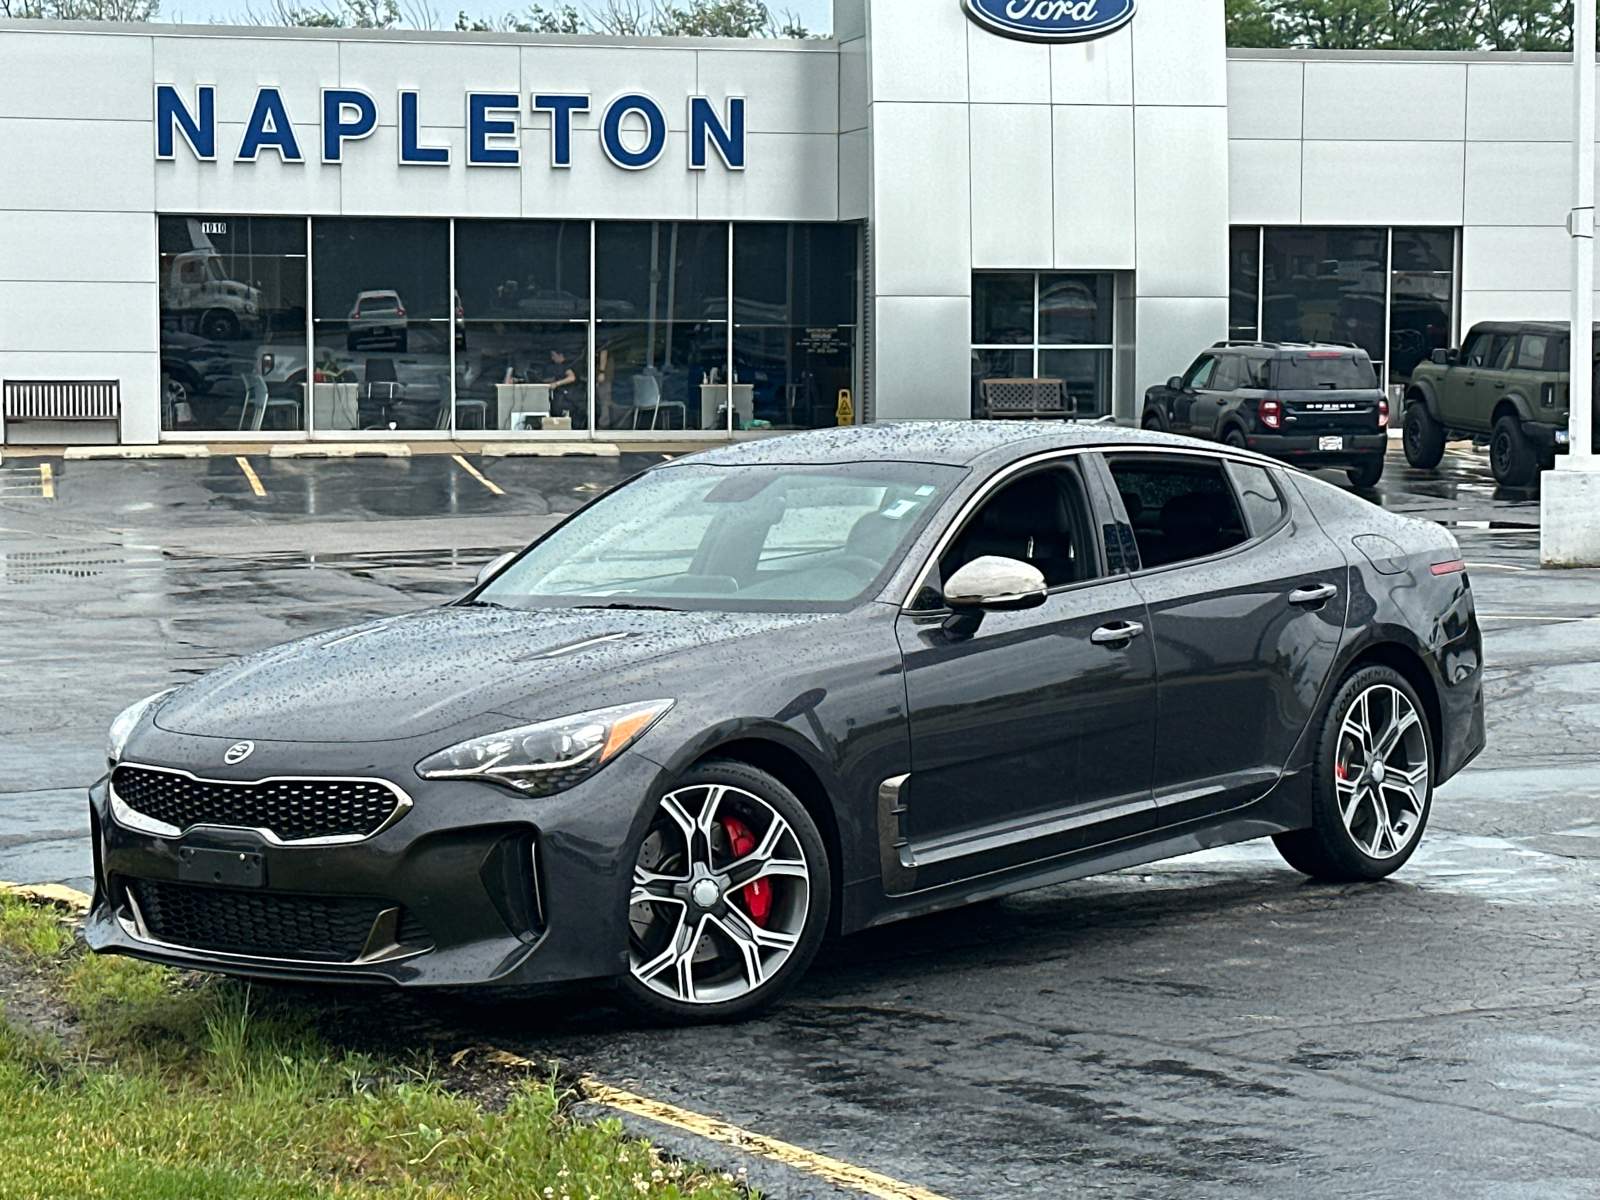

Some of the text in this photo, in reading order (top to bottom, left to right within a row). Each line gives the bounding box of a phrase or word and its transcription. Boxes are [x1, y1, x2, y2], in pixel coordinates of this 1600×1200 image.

[1005, 0, 1099, 21] Ford
[155, 84, 746, 170] NAPLETON
[203, 223, 226, 233] 1010
